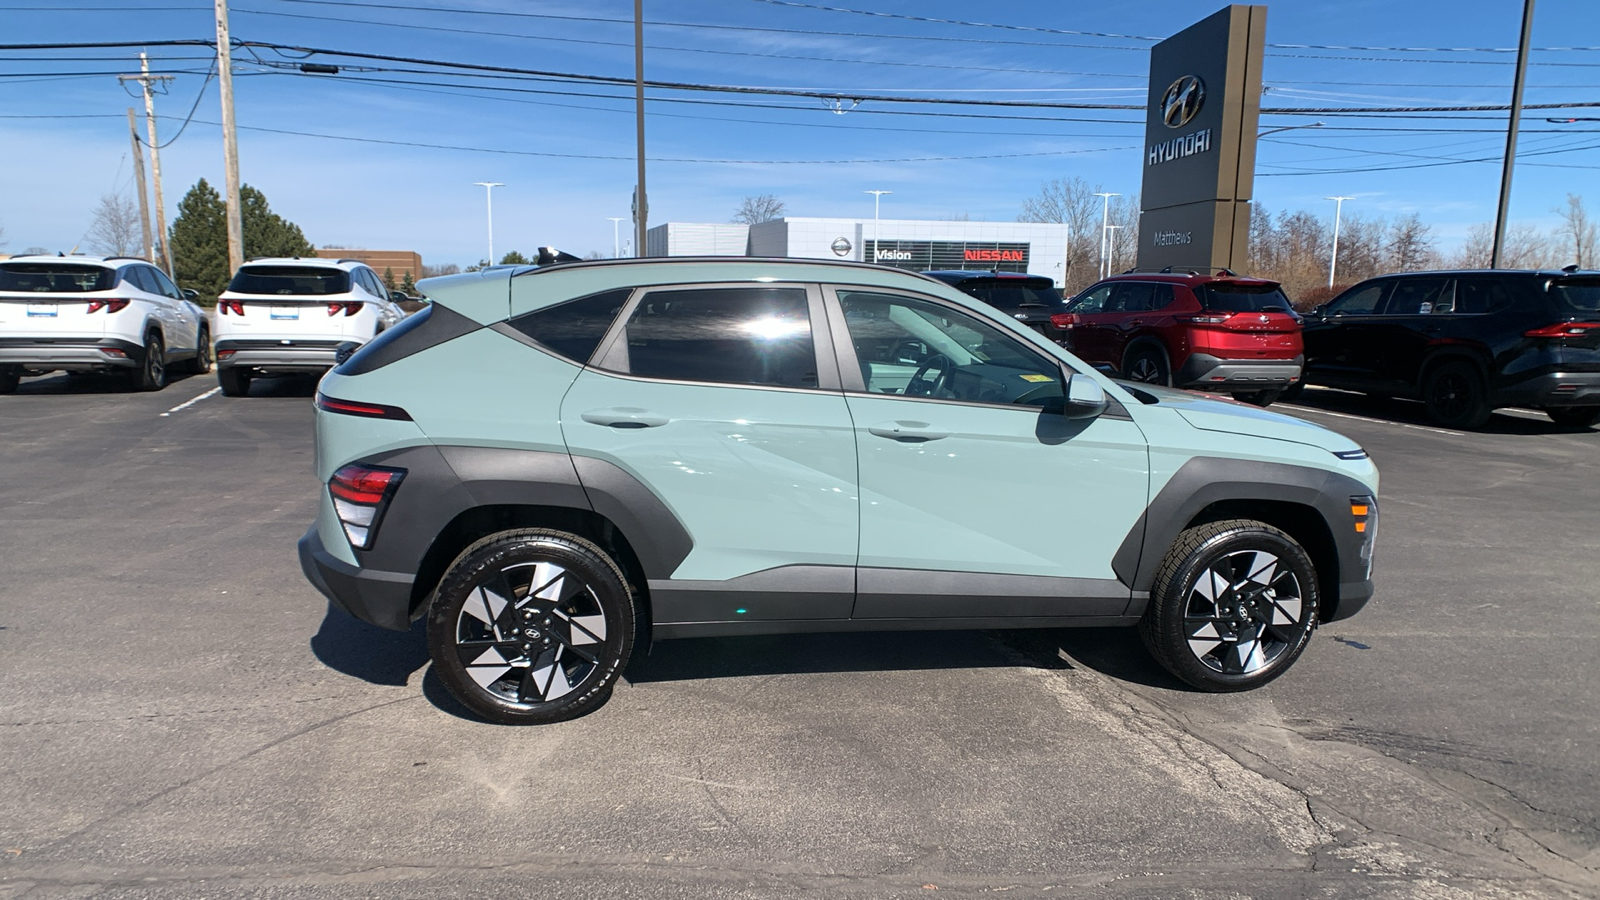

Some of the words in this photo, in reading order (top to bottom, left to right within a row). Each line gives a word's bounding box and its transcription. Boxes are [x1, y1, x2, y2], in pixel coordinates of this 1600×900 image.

[1149, 128, 1212, 165] HYUNDAI
[1154, 230, 1193, 247] Matthews
[876, 250, 912, 260] Vision
[964, 250, 1023, 261] NISSAN
